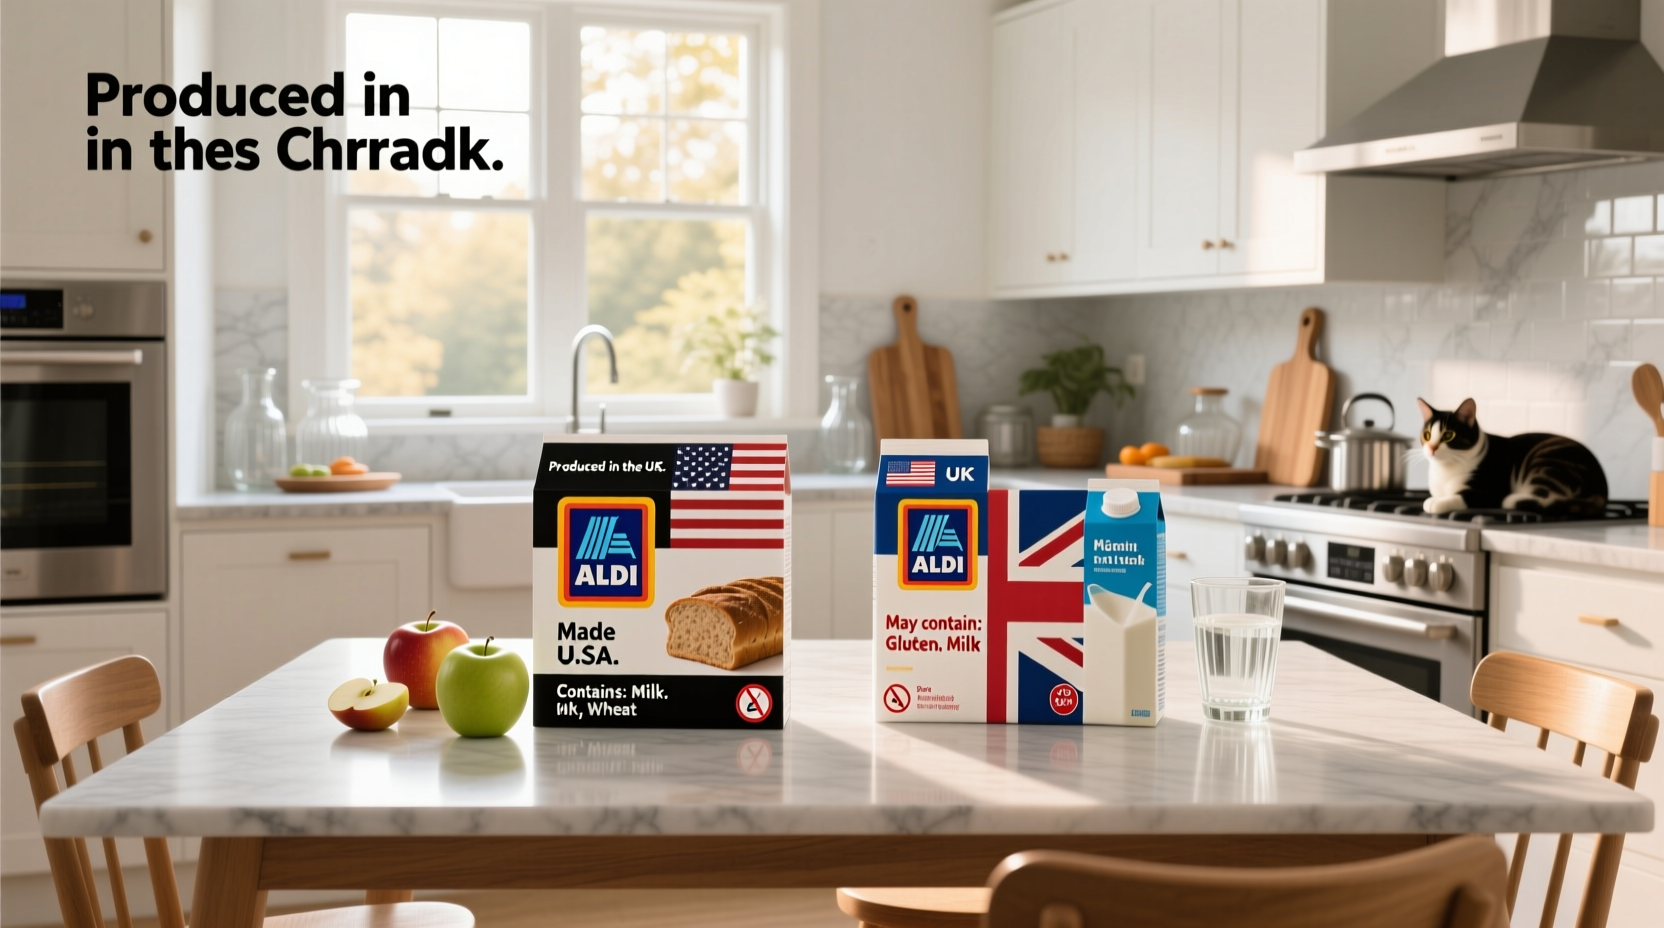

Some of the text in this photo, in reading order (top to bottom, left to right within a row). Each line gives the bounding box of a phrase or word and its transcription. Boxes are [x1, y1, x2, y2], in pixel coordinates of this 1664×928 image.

[548, 459, 606, 472] Produced
[608, 460, 620, 472] in
[622, 459, 643, 472] the
[945, 466, 975, 482] UK
[911, 555, 964, 574] ALDI
[574, 564, 638, 586] ALDI
[557, 621, 616, 641] Made
[885, 614, 982, 634] May contain:
[946, 634, 981, 653] Milk
[556, 683, 627, 699] Contains:
[587, 701, 638, 717] Wheat
